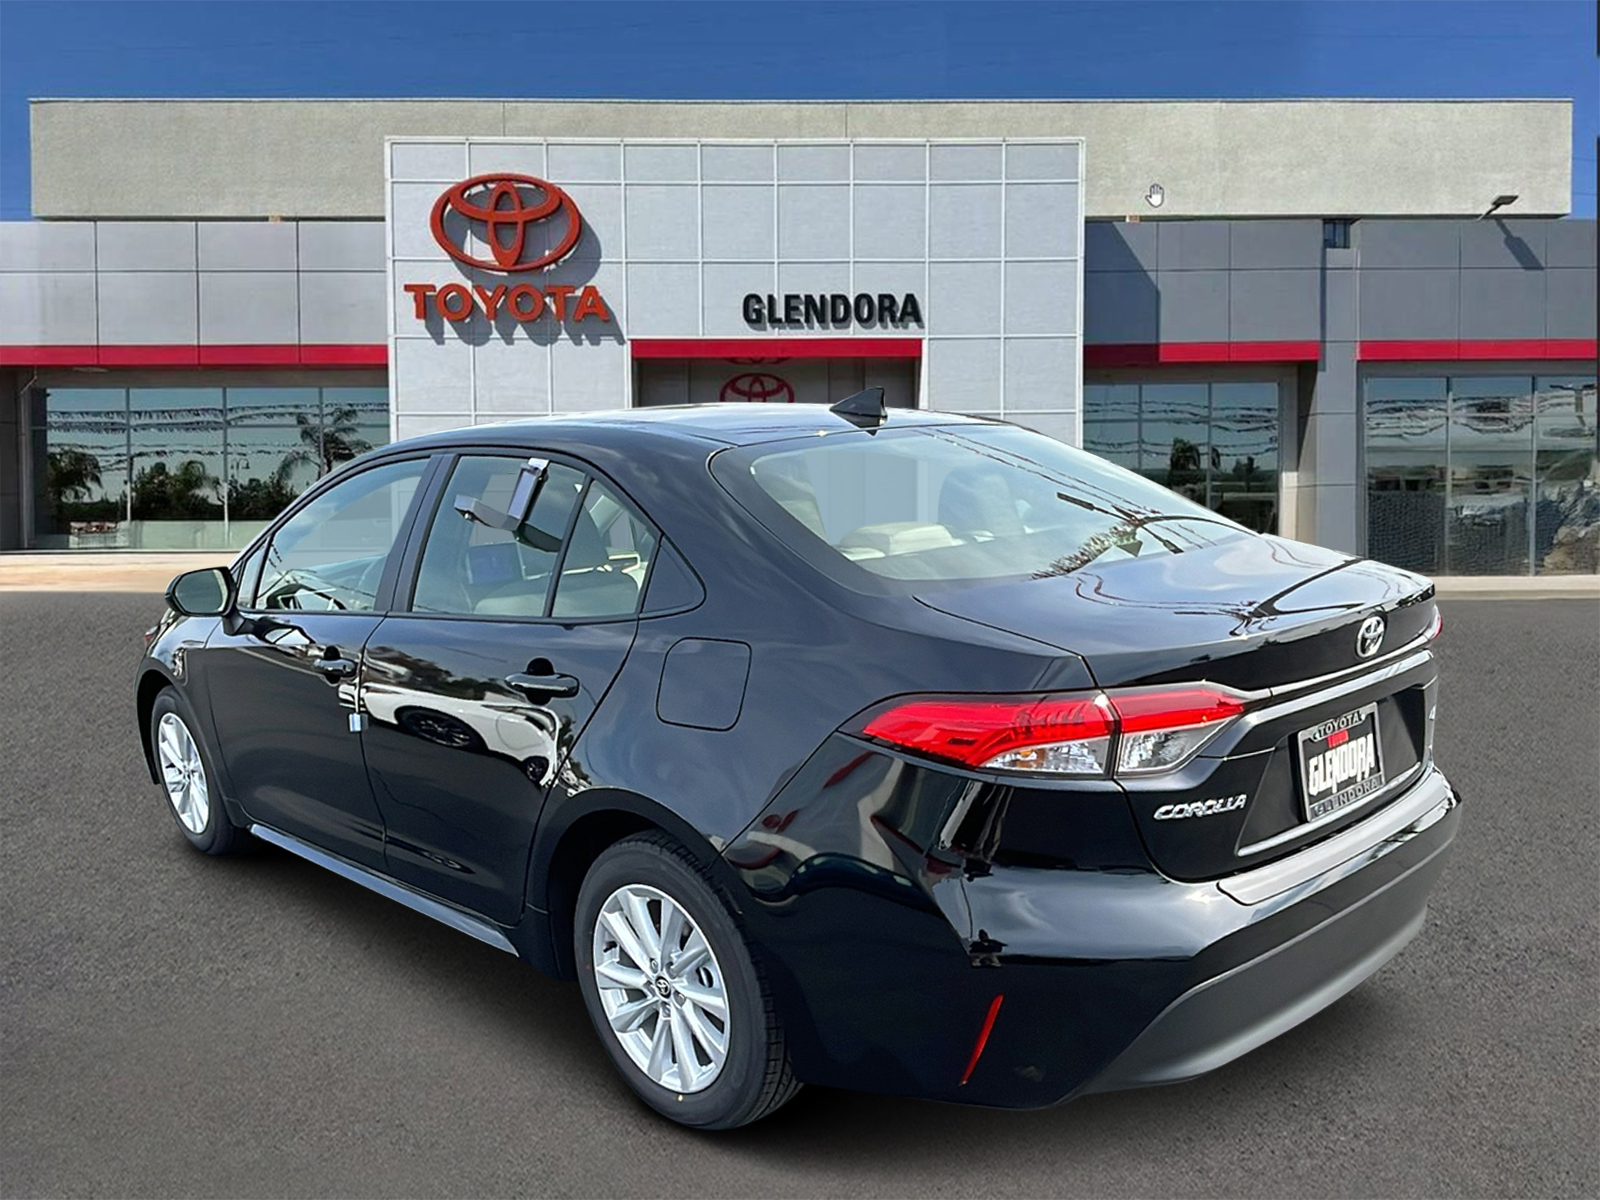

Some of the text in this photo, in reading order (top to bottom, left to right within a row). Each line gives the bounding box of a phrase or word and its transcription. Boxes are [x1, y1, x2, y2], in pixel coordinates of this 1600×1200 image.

[404, 284, 610, 323] TOYOTA
[743, 293, 923, 325] GLENDORA
[1318, 711, 1361, 736] TOYOTA
[1309, 732, 1375, 796] GLENDORA
[1153, 794, 1247, 820] COROLLA
